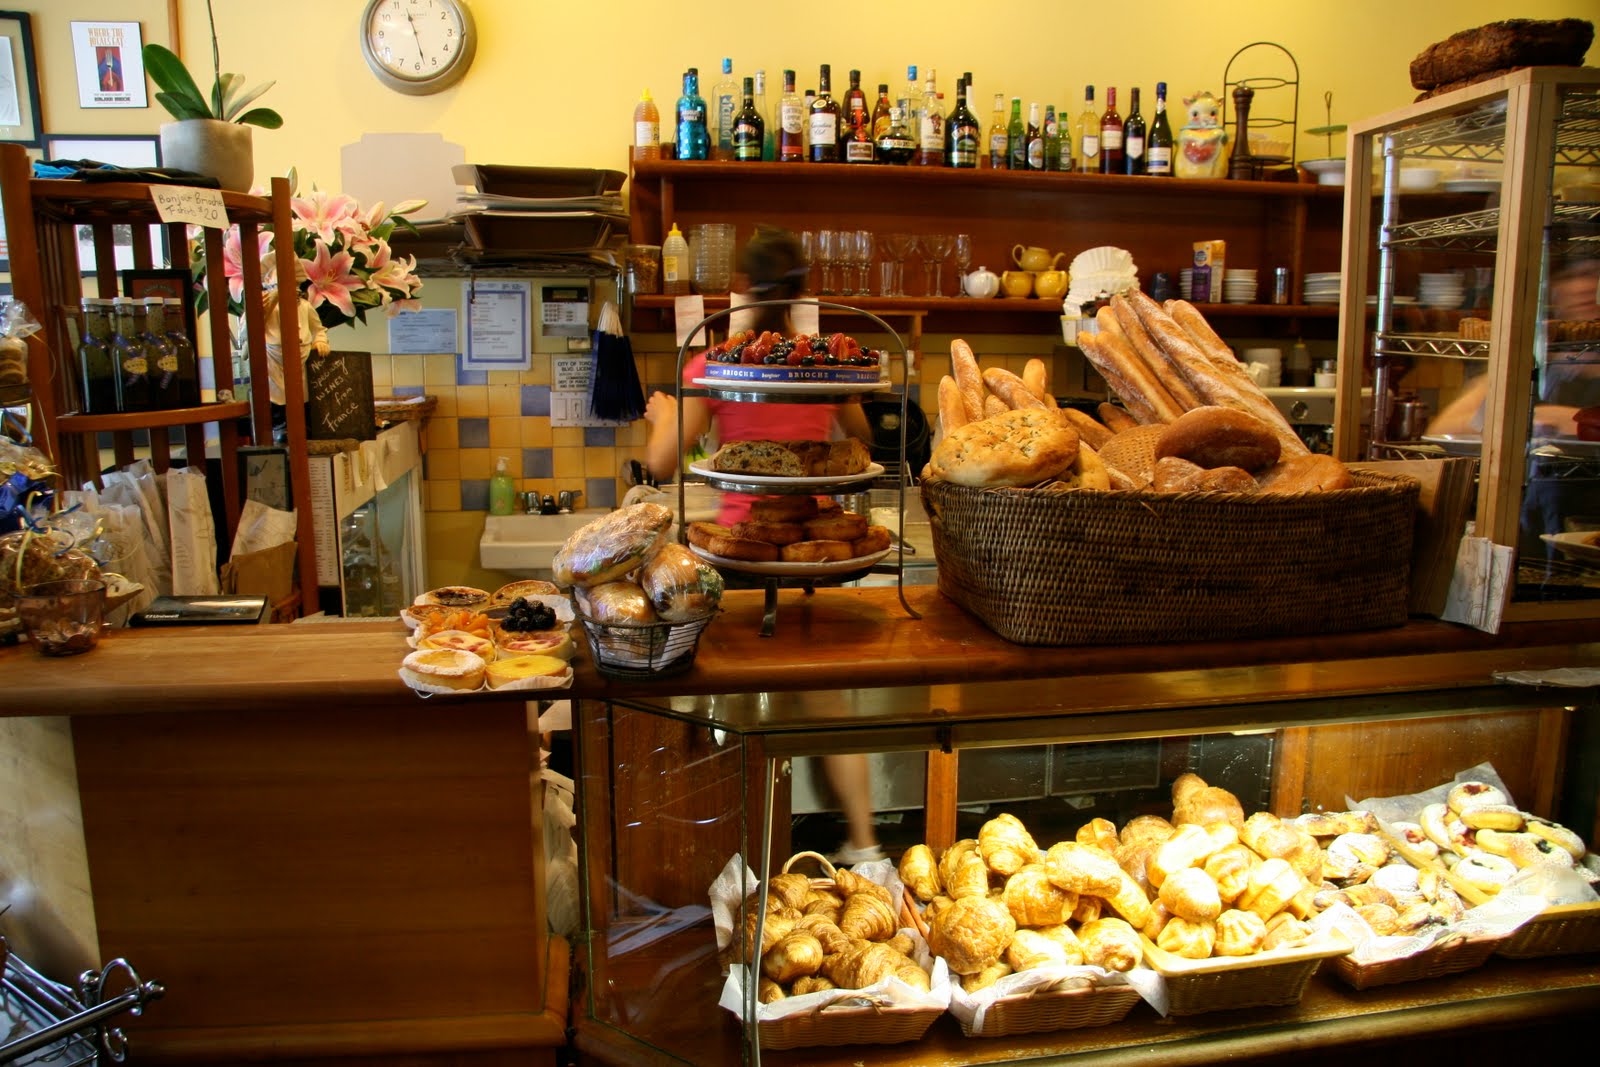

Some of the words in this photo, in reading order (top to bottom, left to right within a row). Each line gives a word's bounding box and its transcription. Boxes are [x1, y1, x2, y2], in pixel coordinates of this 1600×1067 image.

[441, 11, 447, 20] 2
[379, 30, 384, 39] 9
[447, 28, 453, 37] 3
[443, 43, 449, 52] 4
[399, 58, 405, 67] 7
[414, 62, 421, 71] 6
[431, 58, 437, 66] 5
[158, 194, 192, 206] Bonjour
[194, 192, 223, 207] Brioche
[722, 369, 755, 377] BRIOCHE
[788, 371, 829, 379] BRIOCHE
[322, 402, 359, 432] France
